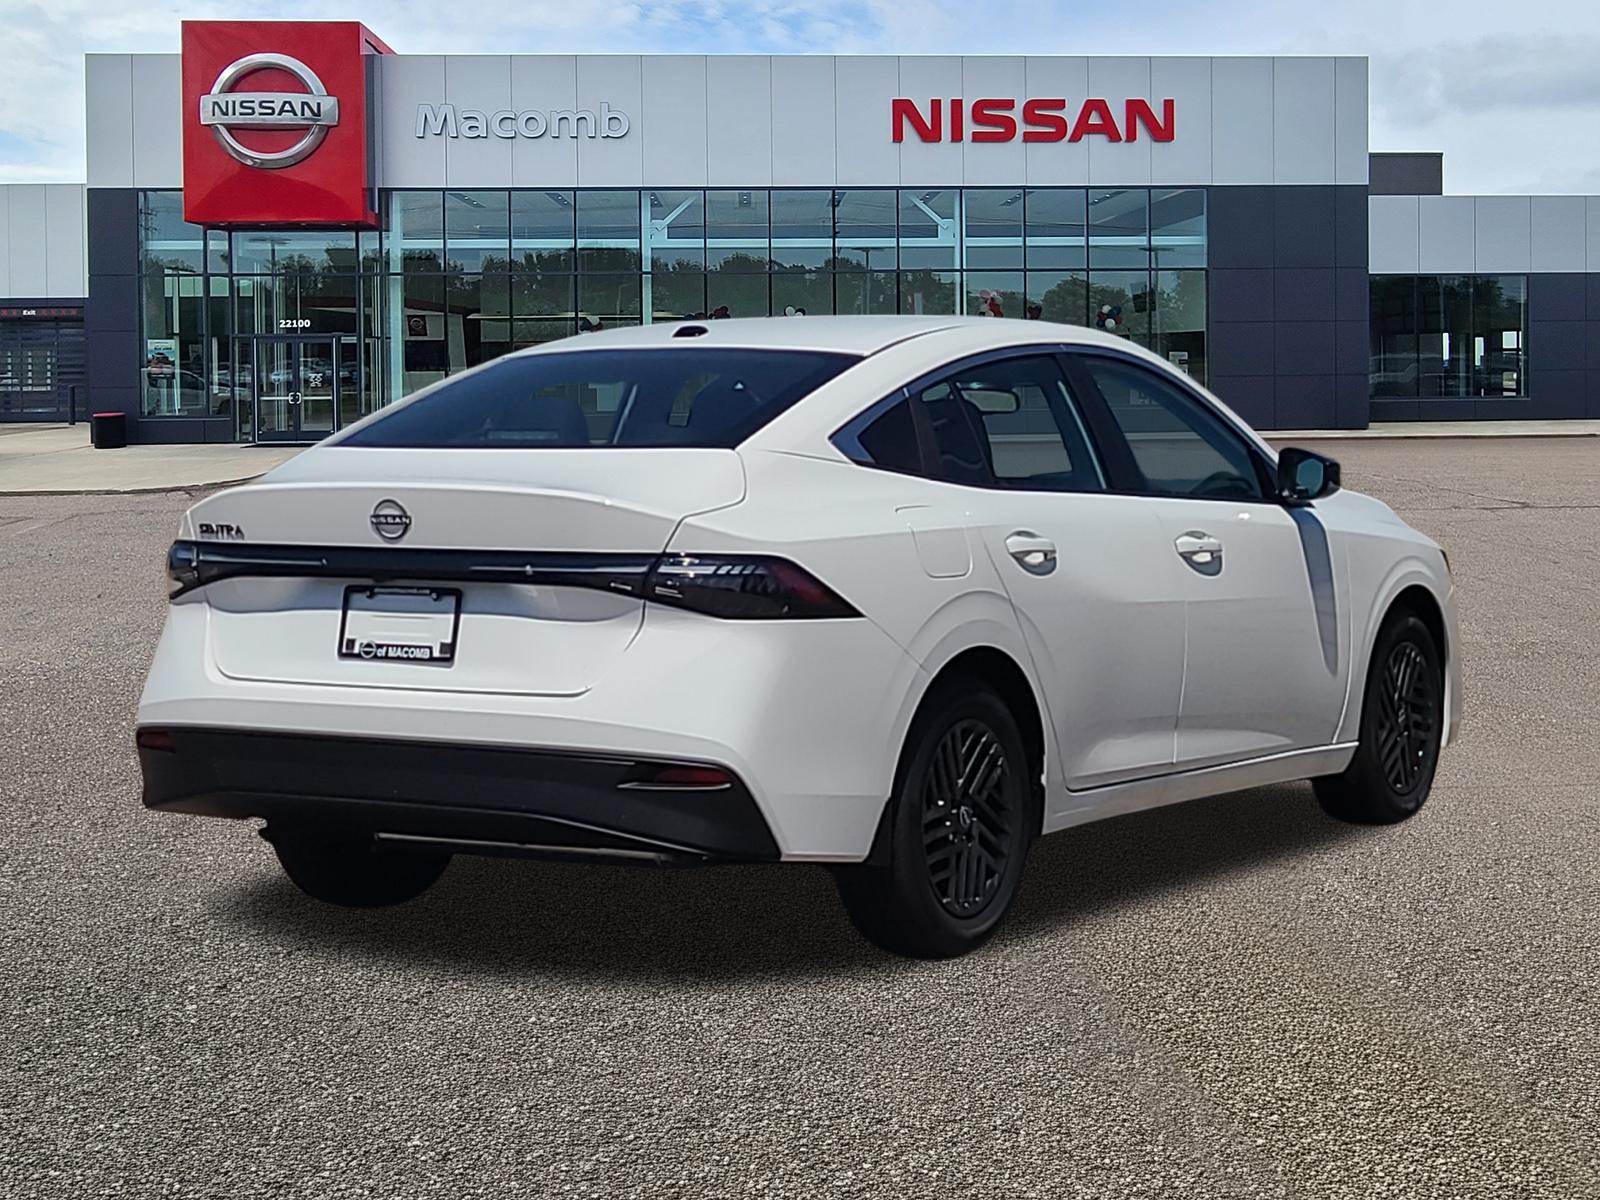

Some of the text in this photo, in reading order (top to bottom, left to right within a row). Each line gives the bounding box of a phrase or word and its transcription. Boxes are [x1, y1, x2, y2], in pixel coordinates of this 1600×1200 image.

[212, 100, 322, 118] NISSAN
[415, 102, 630, 139] Macomb
[892, 99, 1175, 143] NISSAN
[279, 319, 311, 328] 22100
[371, 515, 410, 525] NISSAN
[376, 646, 387, 657] of
[387, 646, 430, 659] MACOMB
